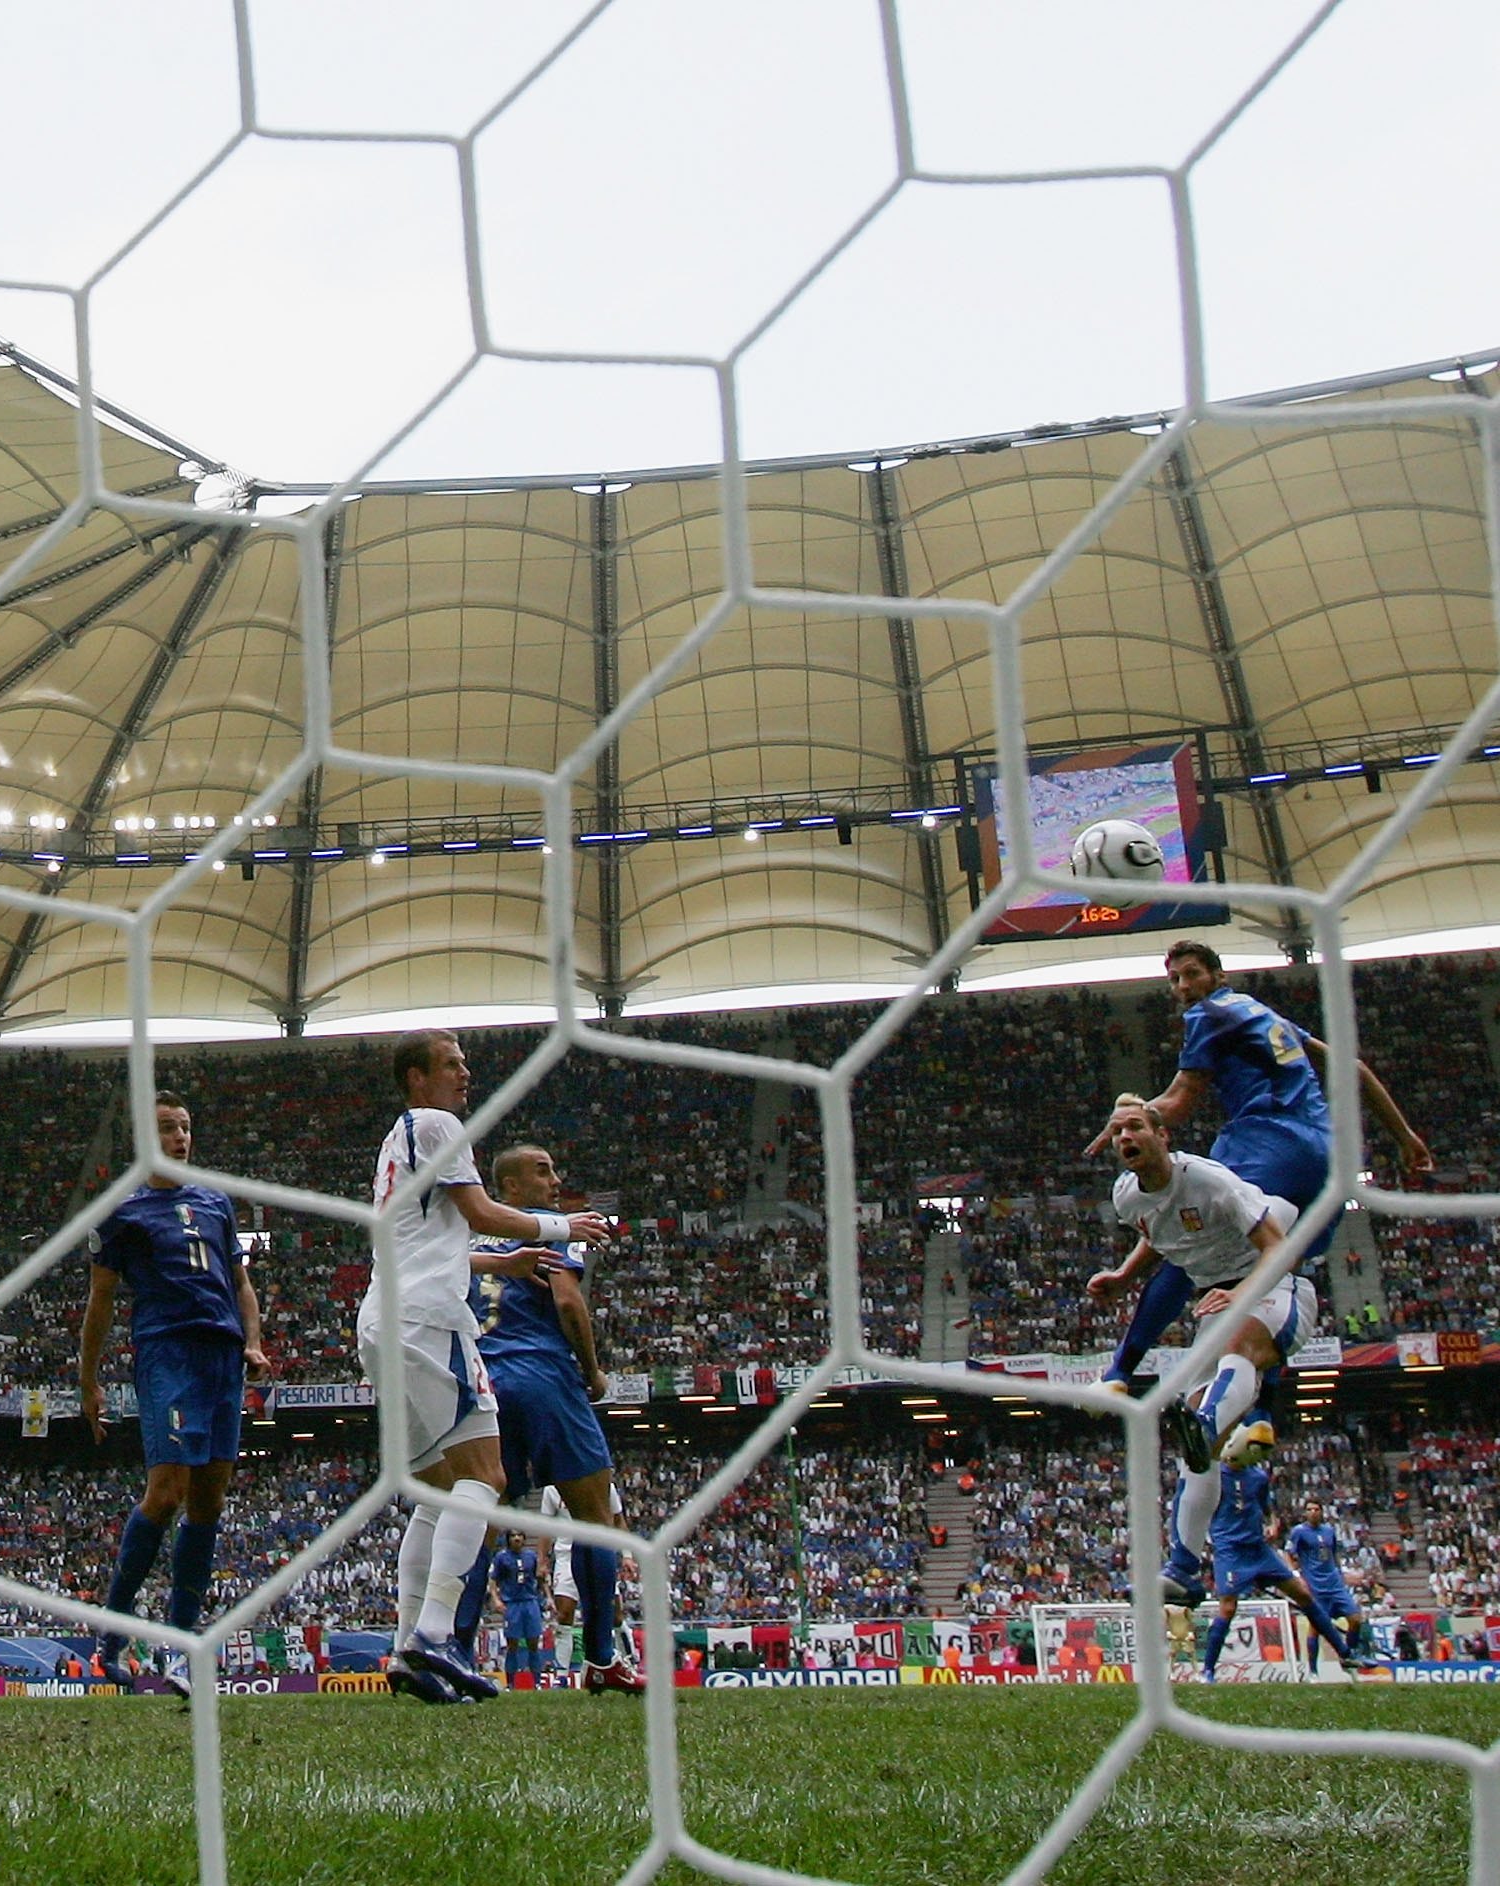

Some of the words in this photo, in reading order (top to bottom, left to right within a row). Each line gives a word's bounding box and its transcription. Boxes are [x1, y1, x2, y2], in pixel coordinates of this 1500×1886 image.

[188, 1240, 209, 1271] 11
[277, 1387, 334, 1405] PESCARA
[1099, 1621, 1133, 1633] TOR
[1101, 1650, 1136, 1663] GRE
[215, 1677, 278, 1695] HOO!
[322, 1678, 390, 1694] Contin
[751, 1669, 898, 1688] HYUNDAI
